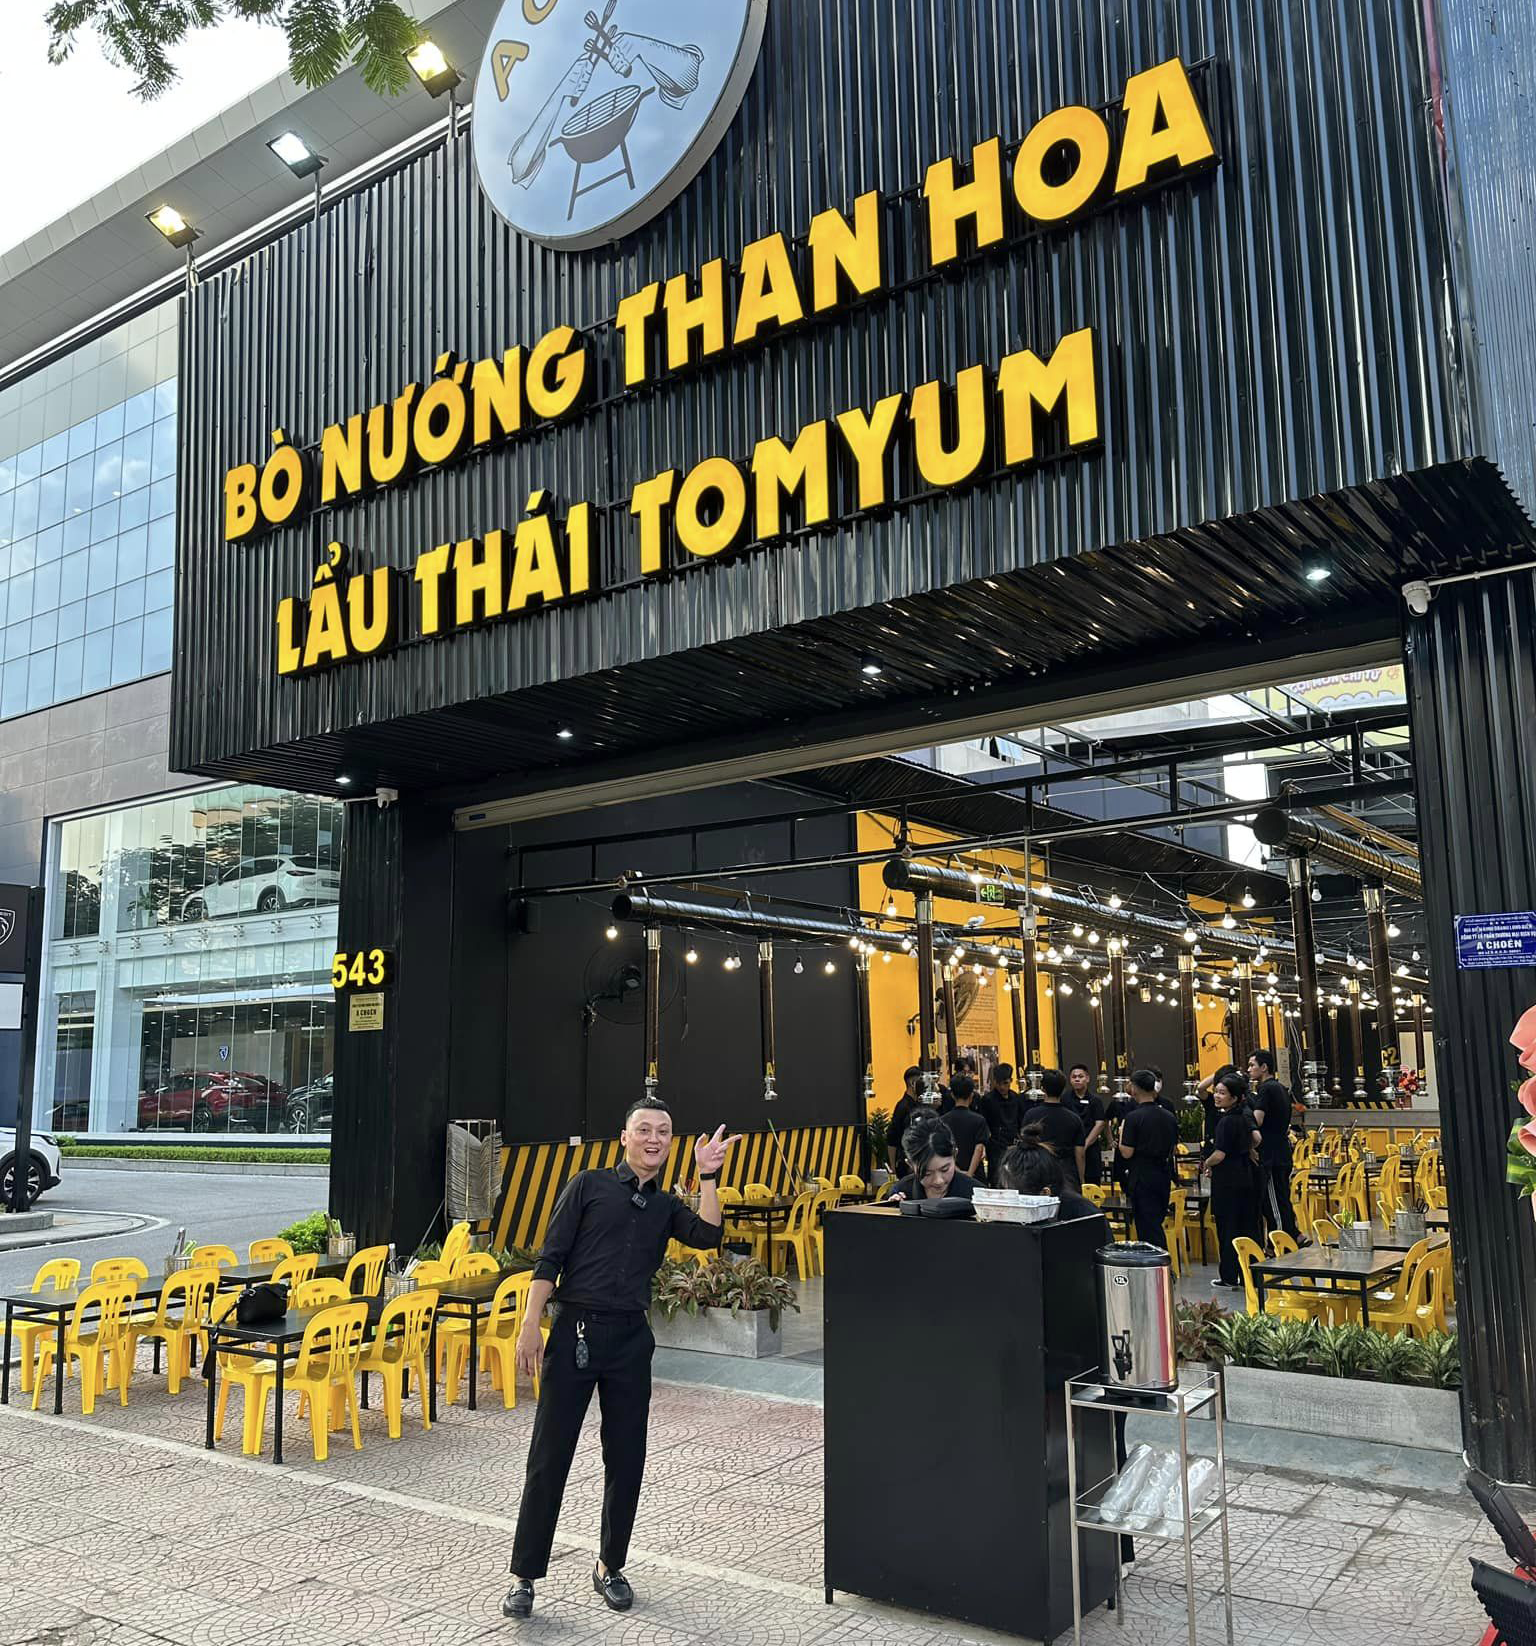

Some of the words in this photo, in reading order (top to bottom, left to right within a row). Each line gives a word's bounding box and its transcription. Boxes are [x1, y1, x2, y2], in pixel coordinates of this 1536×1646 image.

[225, 428, 302, 541] BÒ
[321, 325, 585, 504] NƯỚNG
[615, 192, 881, 386] THAN
[923, 57, 1215, 265] HOA
[277, 541, 389, 674] LẨU
[415, 488, 590, 635] THÁI
[631, 329, 1099, 574] TOMYUM
[331, 948, 385, 988] 543
